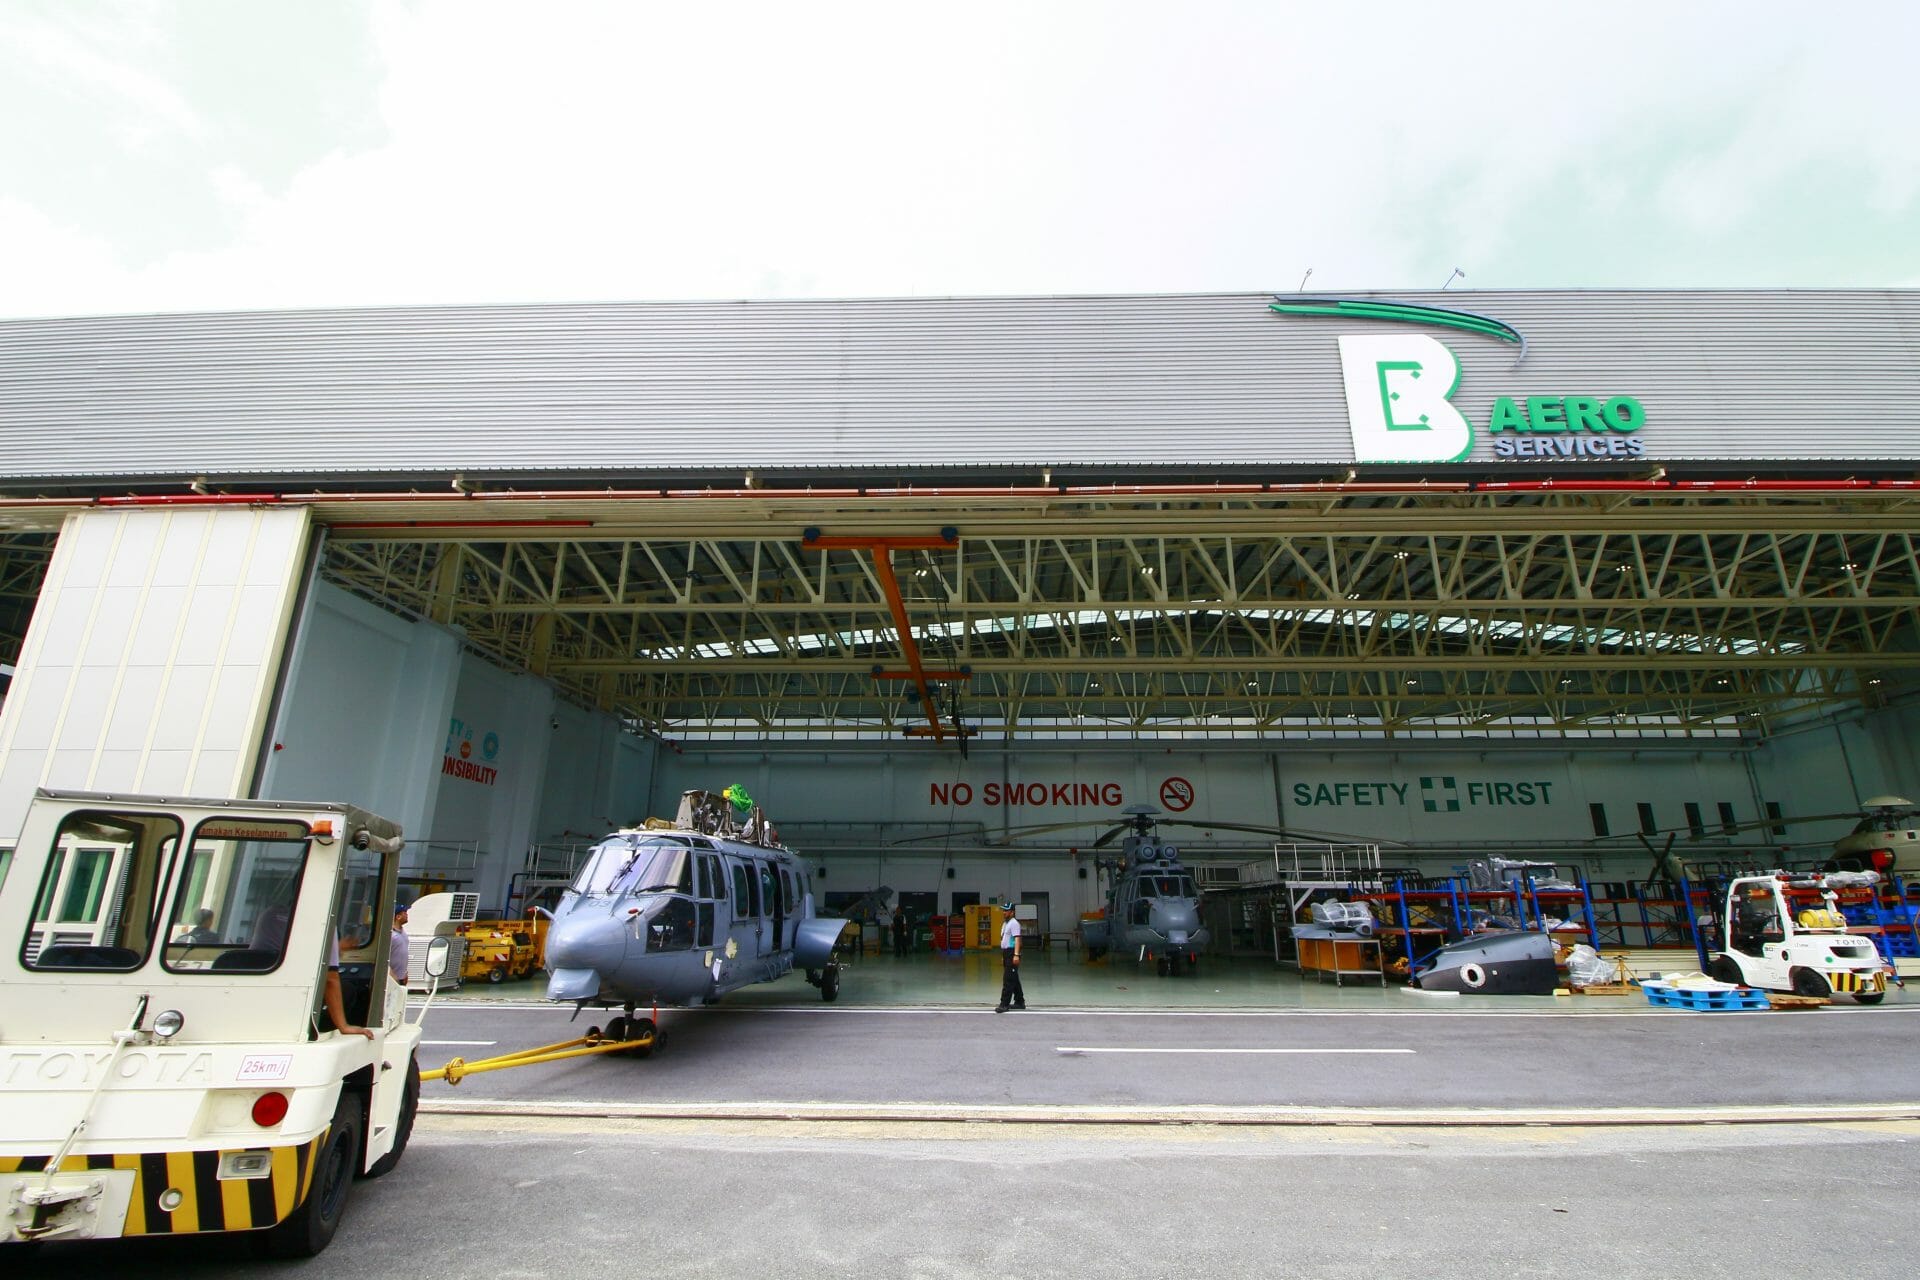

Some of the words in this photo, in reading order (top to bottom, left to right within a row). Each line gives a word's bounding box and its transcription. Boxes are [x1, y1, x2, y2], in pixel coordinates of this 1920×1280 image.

[1489, 396, 1648, 434] AERO
[1494, 436, 1647, 458] SERVICES
[930, 782, 973, 806] NO
[983, 782, 1123, 806] SMOKING
[1293, 782, 1409, 807] SAFETY
[1467, 781, 1553, 805] FIRST
[5, 1051, 214, 1083] TOYOTA
[243, 1060, 288, 1076] 25km/j
